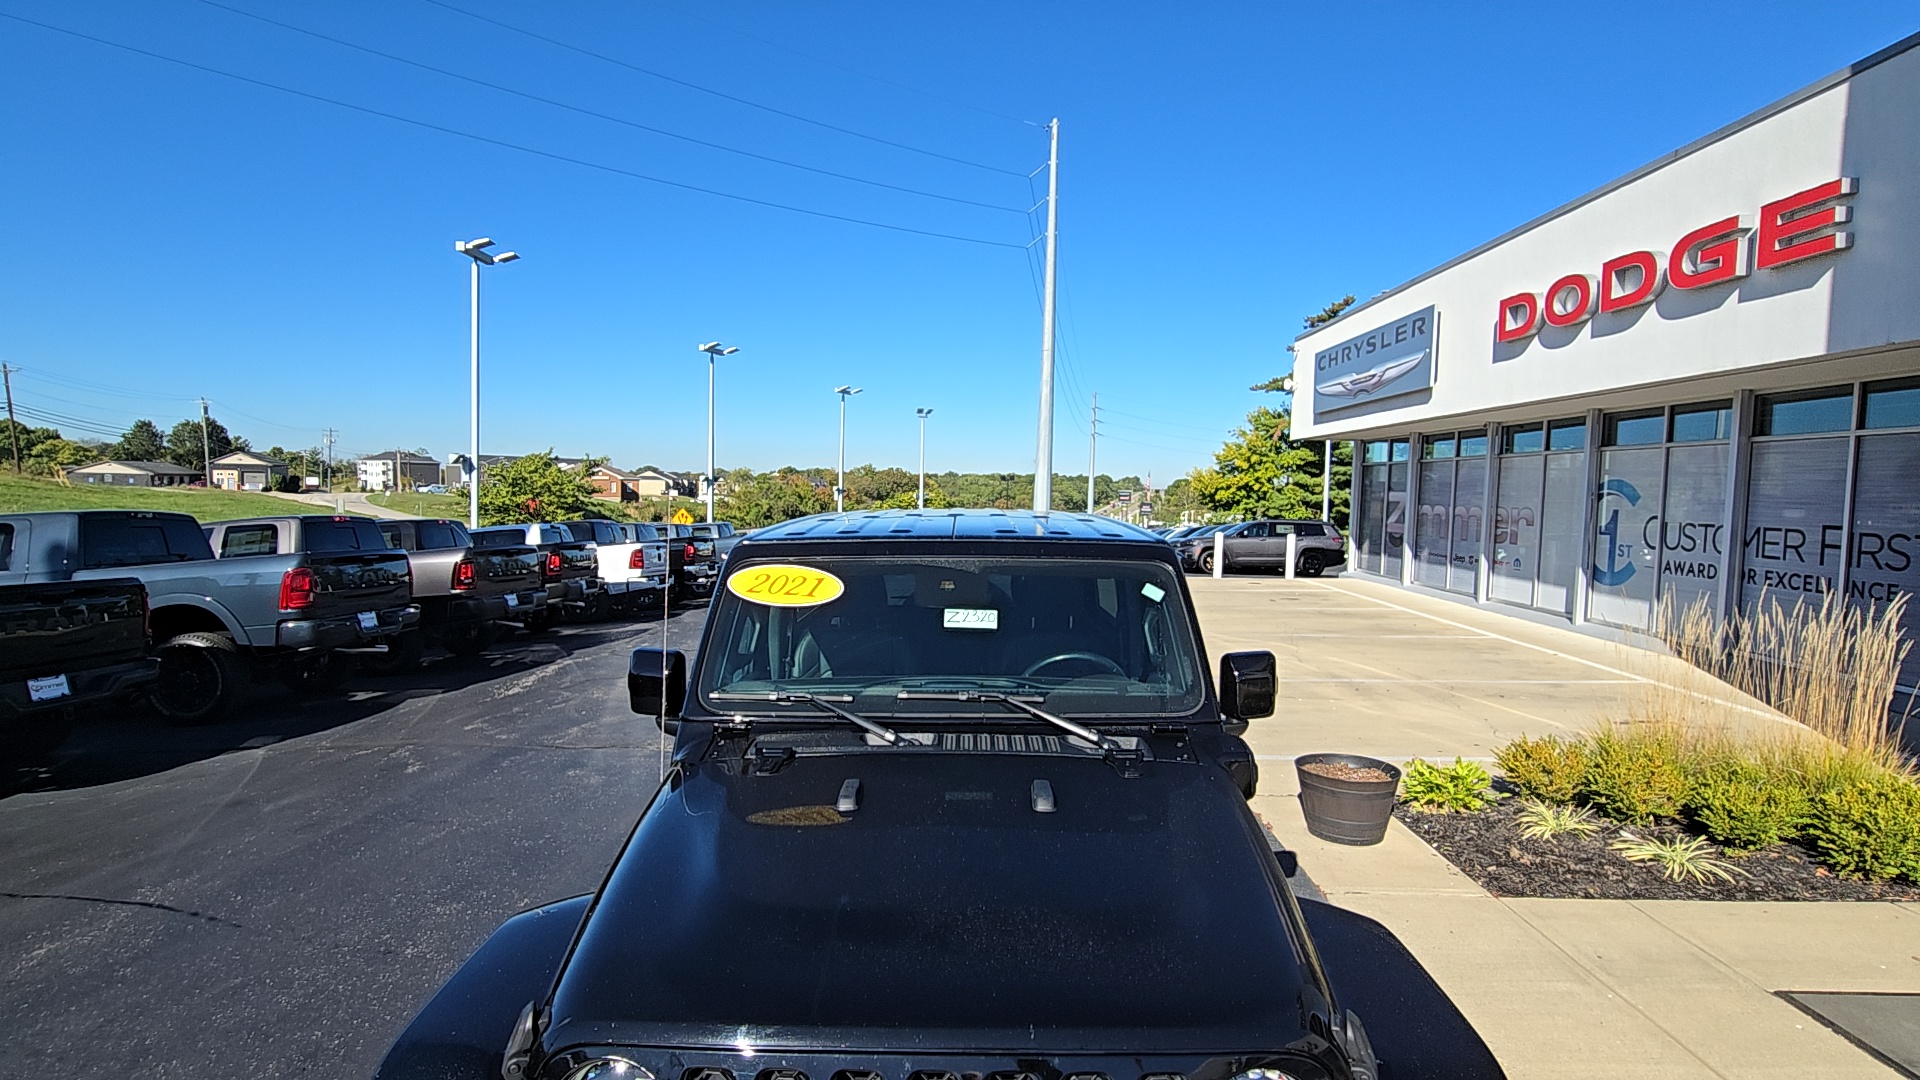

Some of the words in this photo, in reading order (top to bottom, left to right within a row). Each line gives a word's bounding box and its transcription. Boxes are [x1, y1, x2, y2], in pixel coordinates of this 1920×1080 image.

[1497, 178, 1850, 342] DODGE
[1317, 316, 1426, 371] CHRYSLER
[1387, 491, 1534, 545] Zmmer
[342, 570, 393, 584] RAM
[1663, 560, 1718, 581] AWARD
[746, 573, 825, 597] 2021
[7, 613, 100, 635] RAM
[947, 609, 995, 623] Z2320
